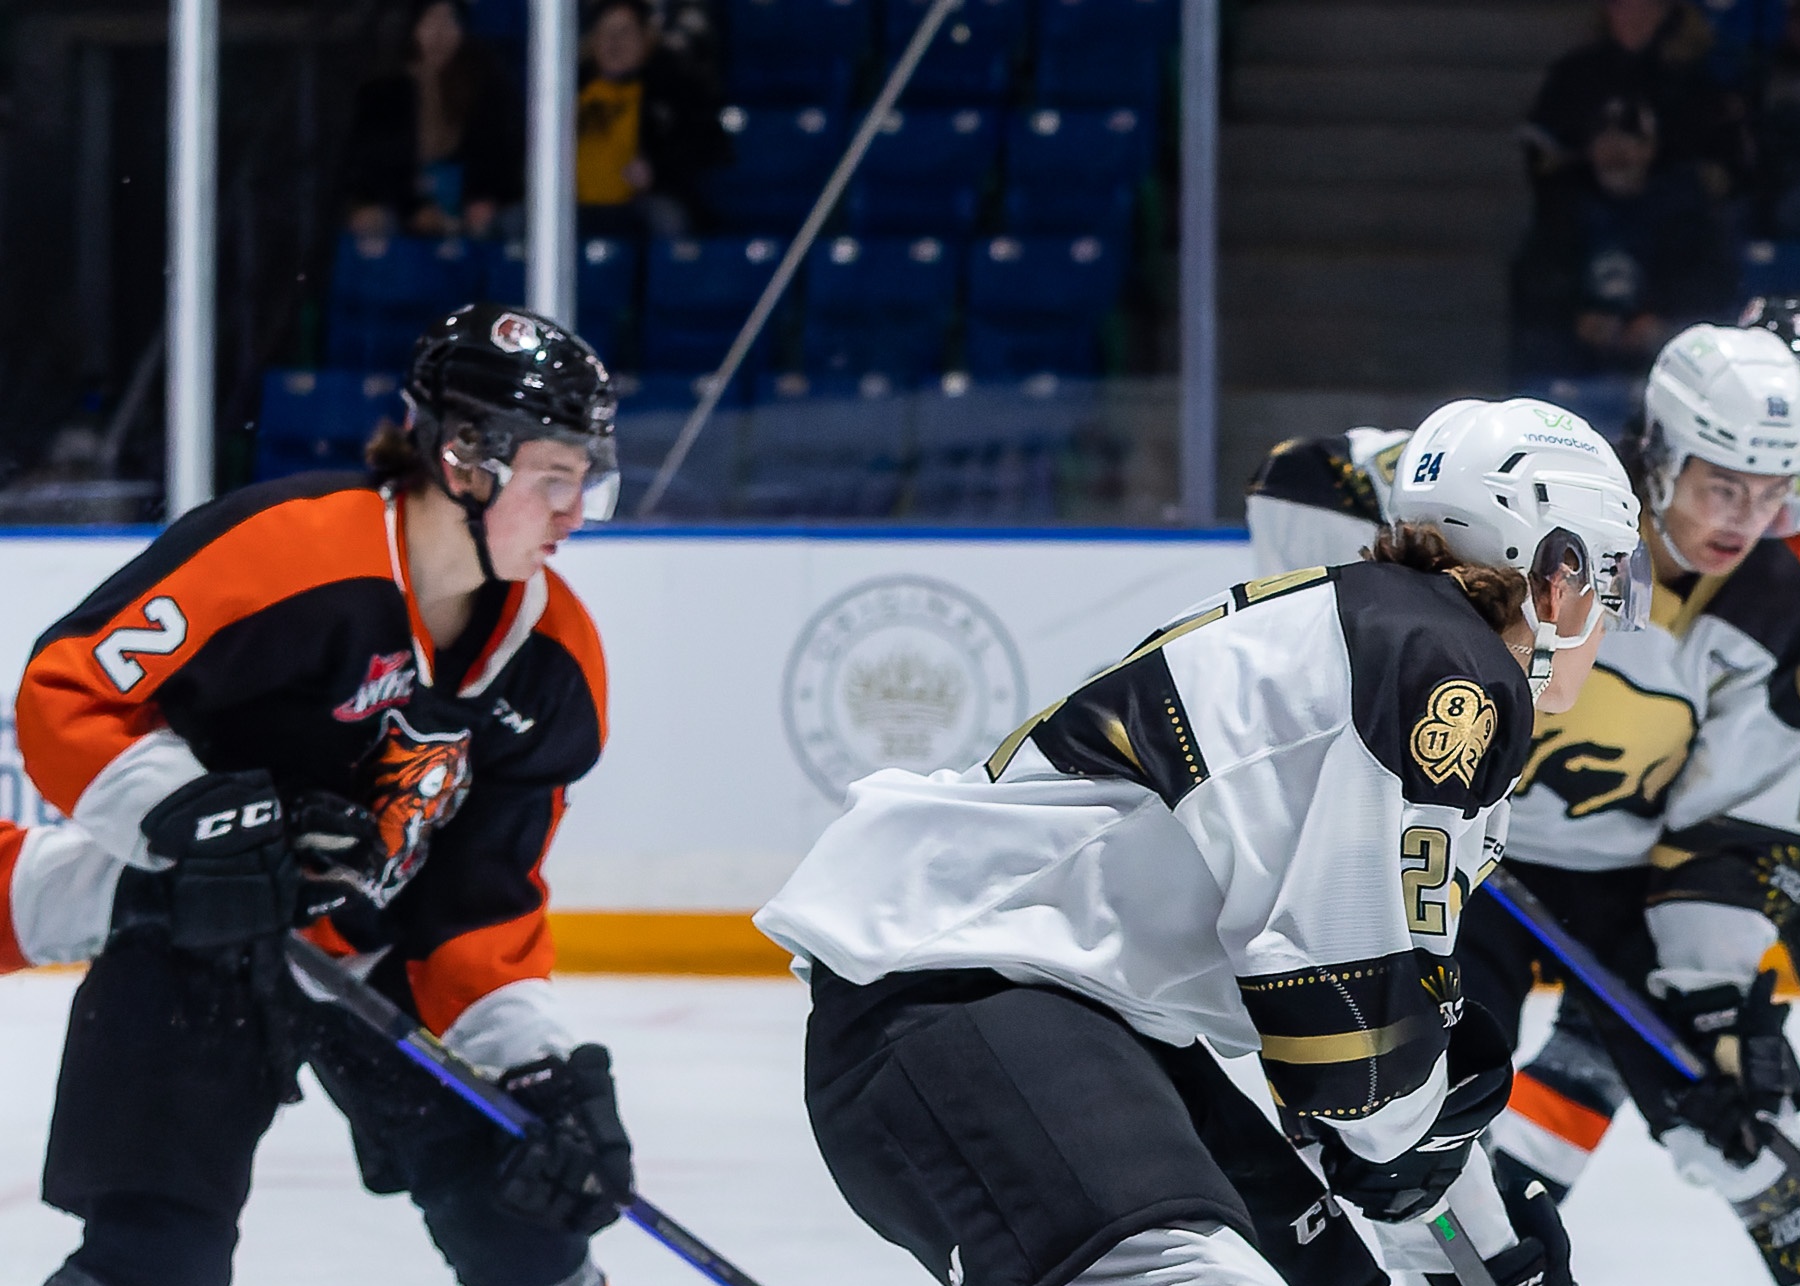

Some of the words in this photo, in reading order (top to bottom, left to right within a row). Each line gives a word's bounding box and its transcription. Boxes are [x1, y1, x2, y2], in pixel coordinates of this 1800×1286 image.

[1521, 432, 1600, 456] innovation
[1412, 450, 1446, 484] 24
[95, 597, 188, 693] 2
[1447, 696, 1466, 717] 8
[1426, 730, 1449, 752] 11
